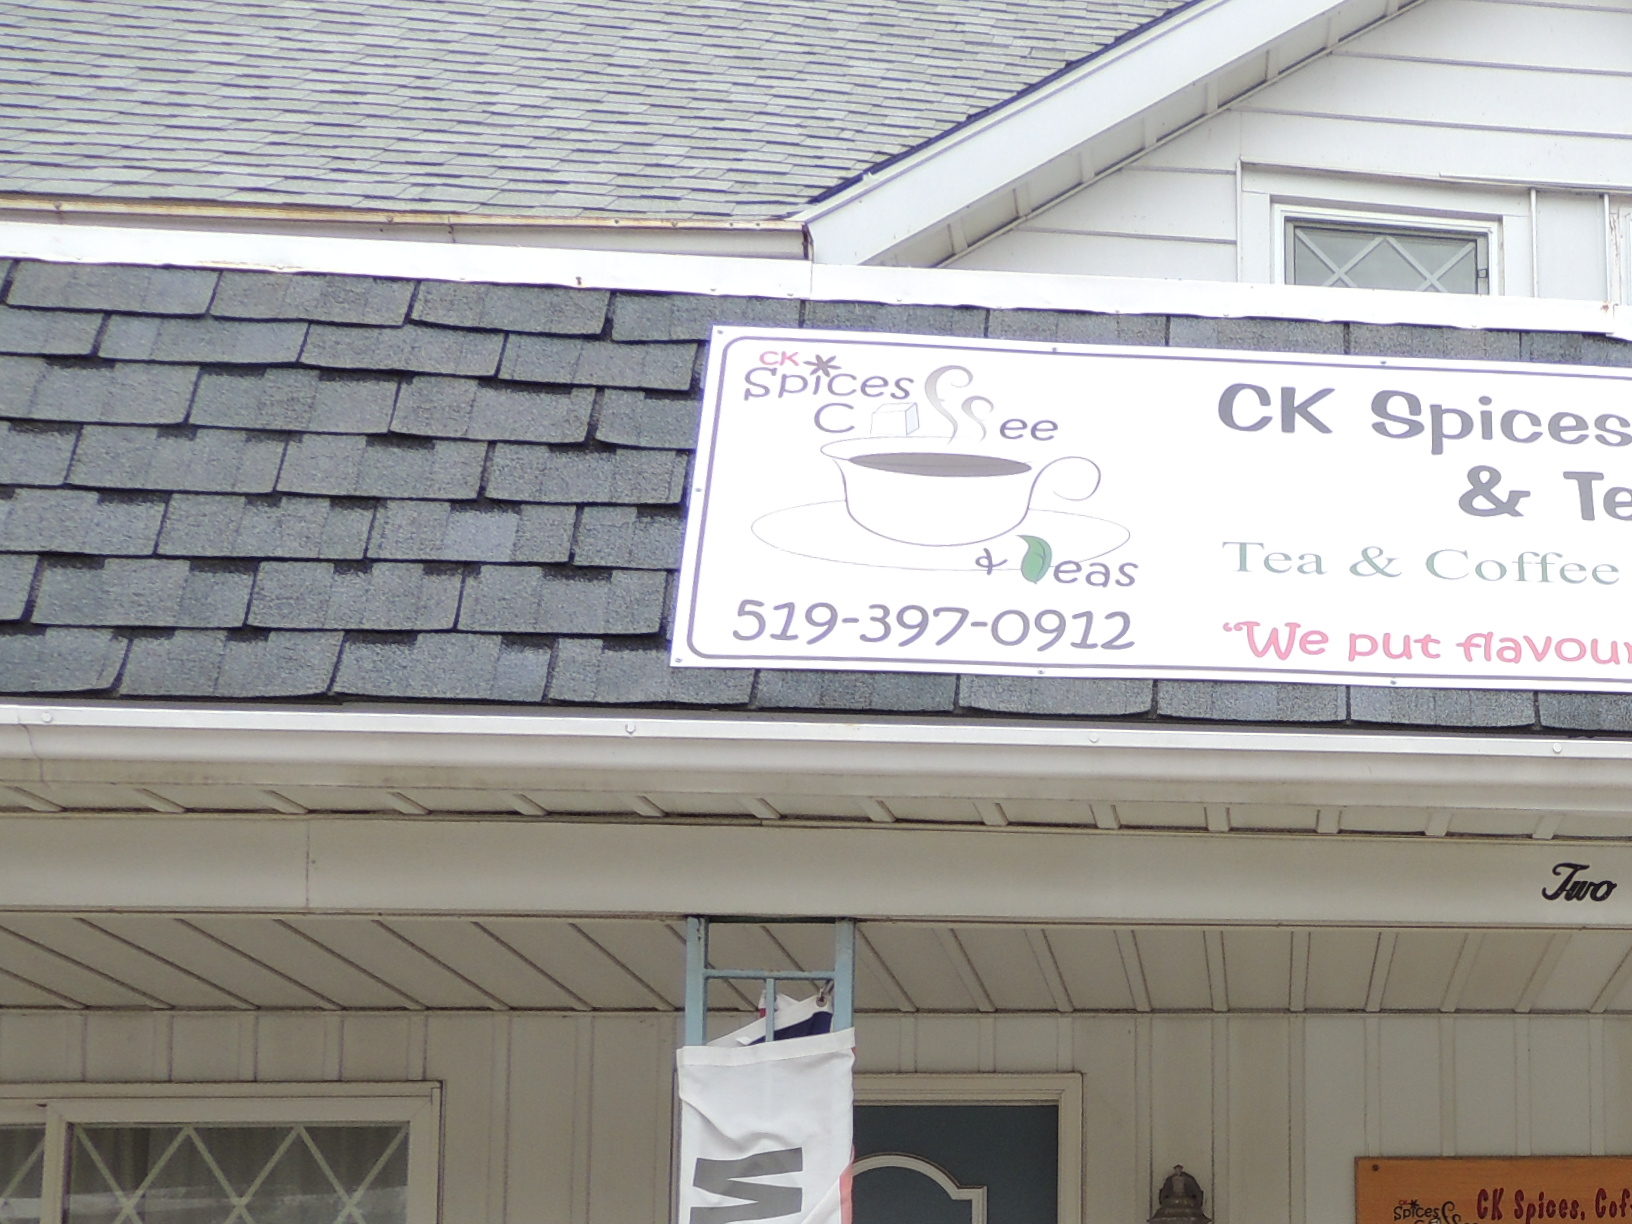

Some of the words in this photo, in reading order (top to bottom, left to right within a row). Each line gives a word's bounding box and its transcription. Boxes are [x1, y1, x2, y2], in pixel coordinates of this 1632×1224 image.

[759, 350, 800, 367] CK
[744, 365, 914, 401] Spices
[1217, 383, 1336, 436] CK
[1457, 465, 1531, 518] &
[1222, 541, 1326, 577] Tea
[1348, 546, 1402, 579] &
[1424, 549, 1620, 587] Coffee
[732, 599, 1135, 652] 519-397-0912
[1347, 628, 1442, 662] put
[1542, 862, 1618, 902] Two
[1393, 1206, 1440, 1221] Spices
[1476, 1187, 1504, 1221] CK
